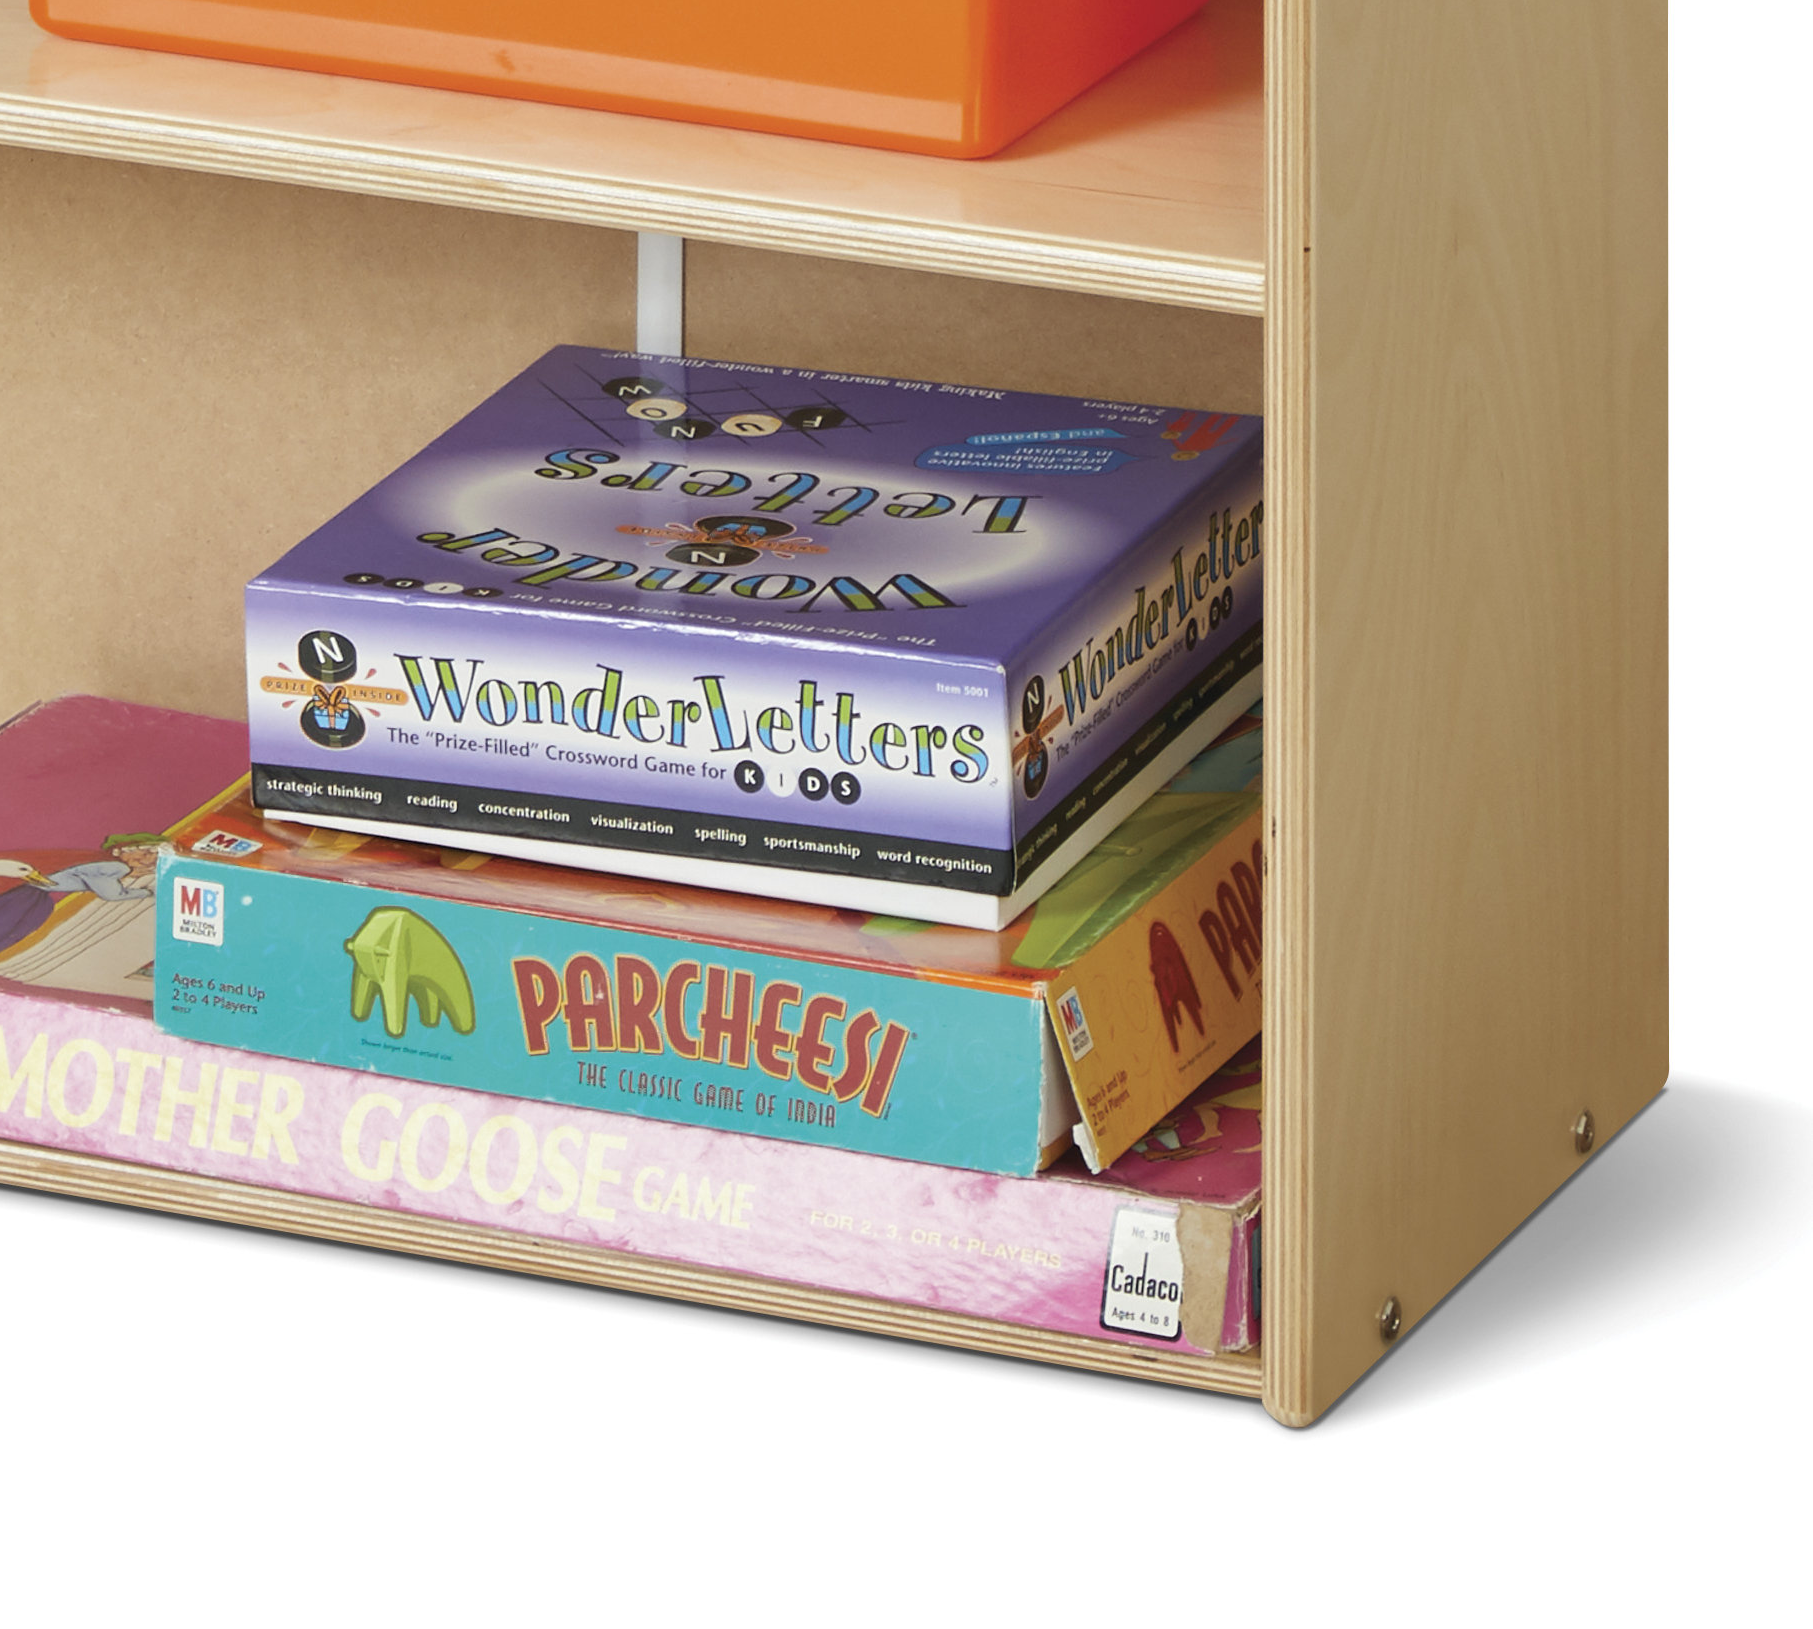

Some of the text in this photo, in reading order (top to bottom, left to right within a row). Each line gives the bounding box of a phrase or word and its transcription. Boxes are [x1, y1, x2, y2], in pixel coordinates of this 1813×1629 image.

[394, 654, 989, 783] WonderLetters
[387, 727, 420, 746] The
[545, 744, 639, 770] Crossword
[644, 754, 696, 777] Game
[701, 762, 727, 781] for
[266, 779, 383, 804] strategic thinking
[407, 793, 458, 812] reading
[478, 800, 570, 823] concentration
[591, 813, 673, 836] visualization
[694, 827, 747, 846] spelling
[763, 835, 860, 858] sportsmanship
[877, 849, 992, 875] word recognition
[513, 952, 908, 1117] PARCHEESI
[577, 1061, 836, 1128] THE CLASSIC GAME OF INDIA
[341, 1093, 627, 1223] GOOSE
[633, 1166, 755, 1230] GAME
[1111, 1252, 1179, 1303] Cadaco
